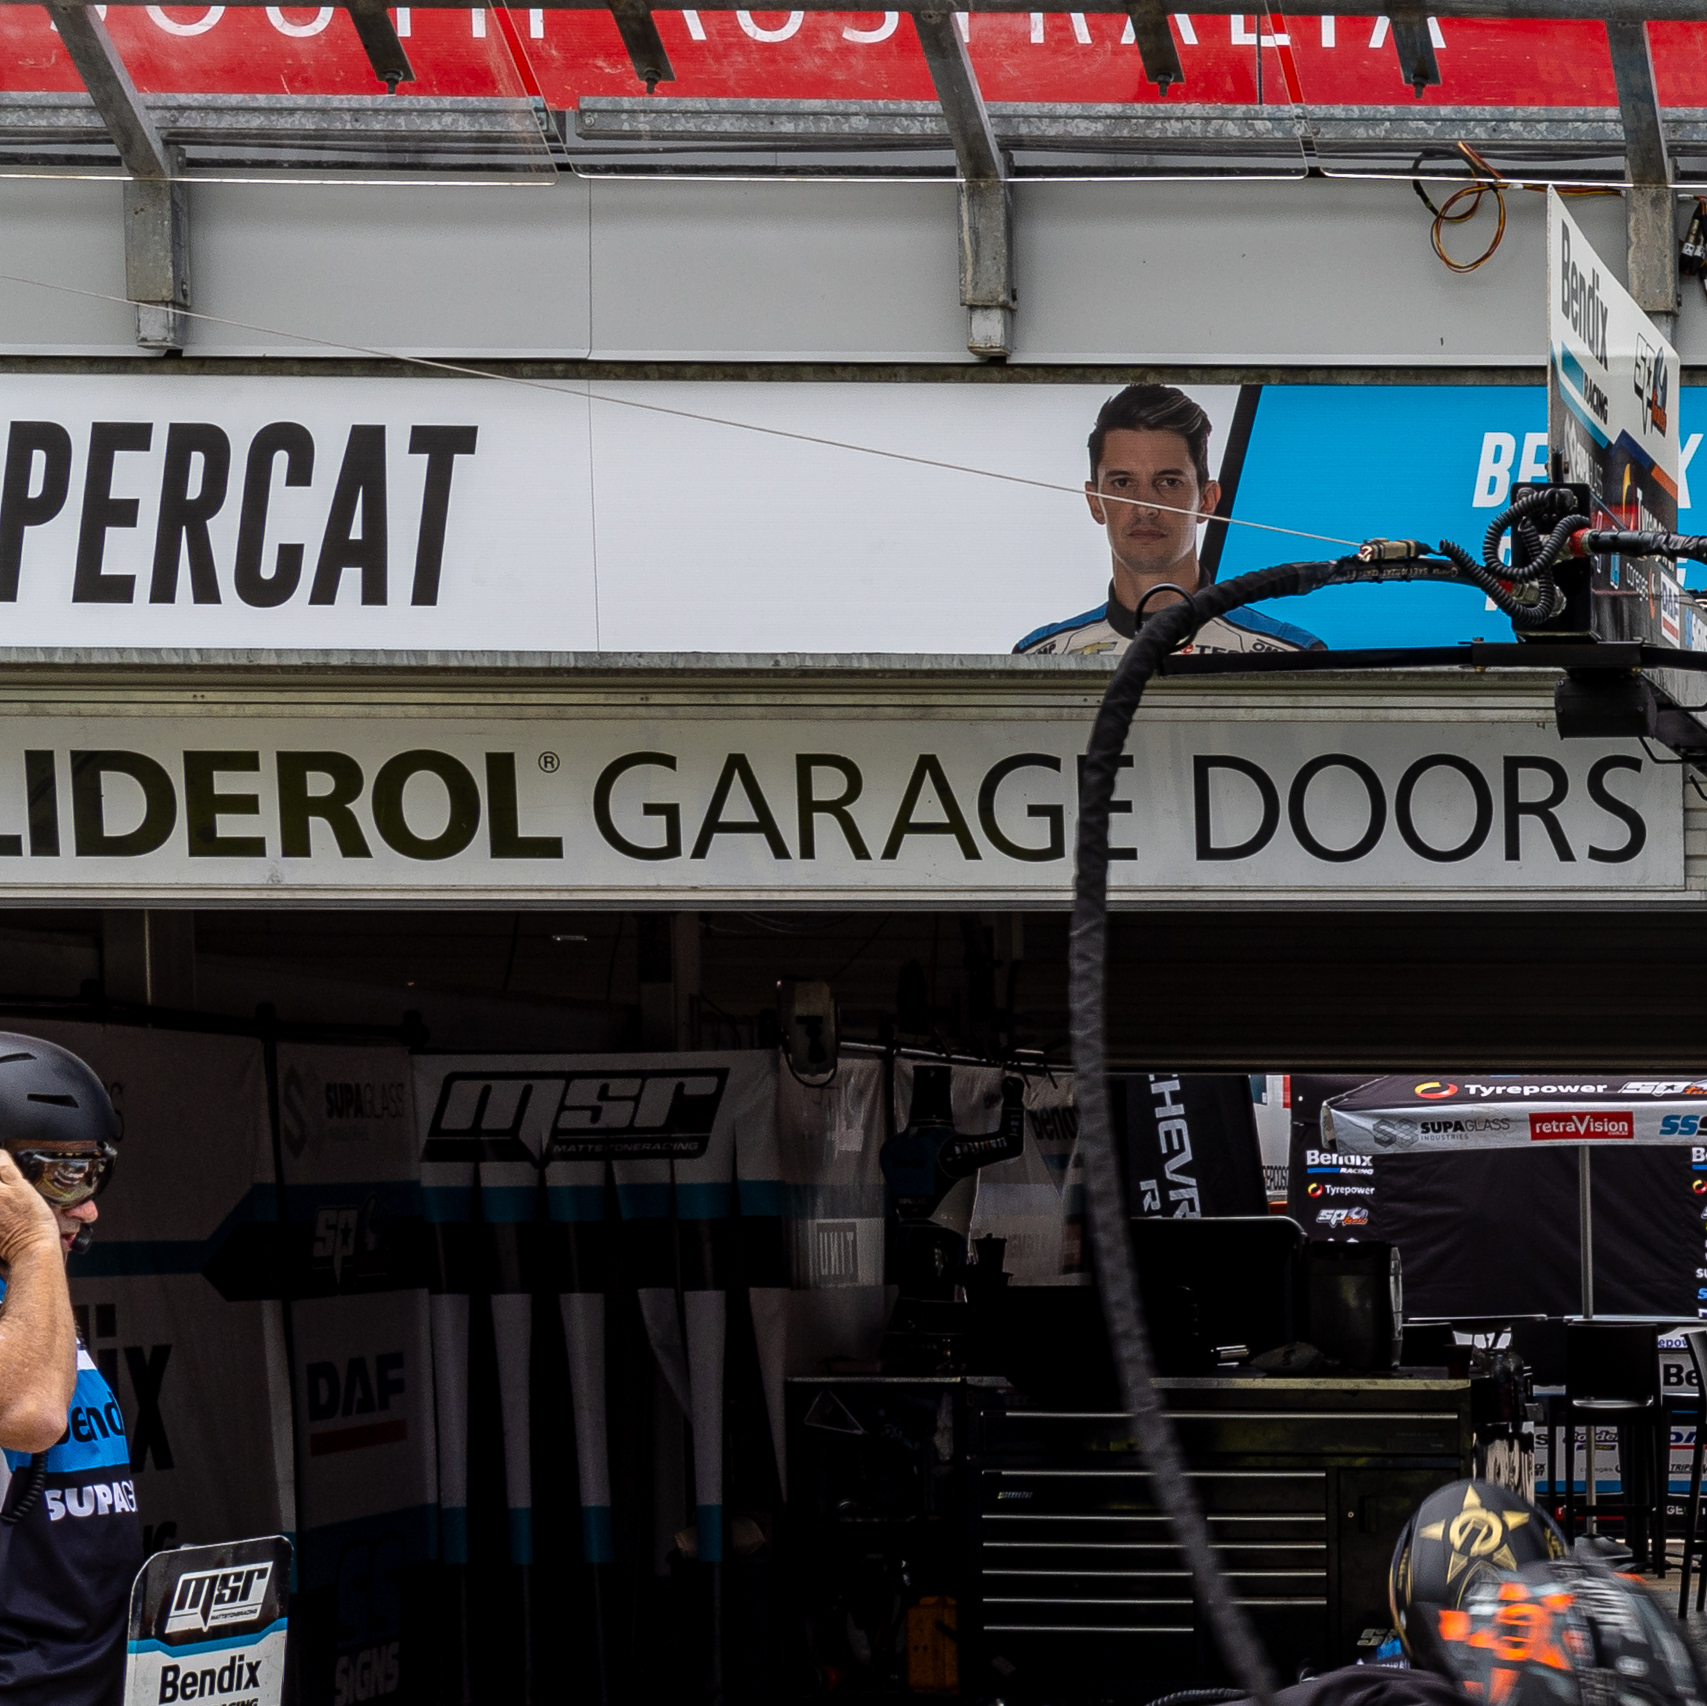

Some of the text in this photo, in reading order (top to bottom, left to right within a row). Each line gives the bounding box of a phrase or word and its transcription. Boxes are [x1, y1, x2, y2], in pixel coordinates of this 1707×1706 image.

[1561, 219, 1608, 372] Bendix
[0, 421, 478, 607] PERCAT
[0, 749, 563, 861] IDEROL
[1192, 752, 1649, 864] DOORS
[1464, 1083, 1607, 1098] Tyrepower
[1420, 1117, 1511, 1134] SUPAGLASS
[1324, 1184, 1376, 1197] Tyrepower
[306, 1352, 405, 1421] DAF
[158, 1653, 262, 1706] Bendix
